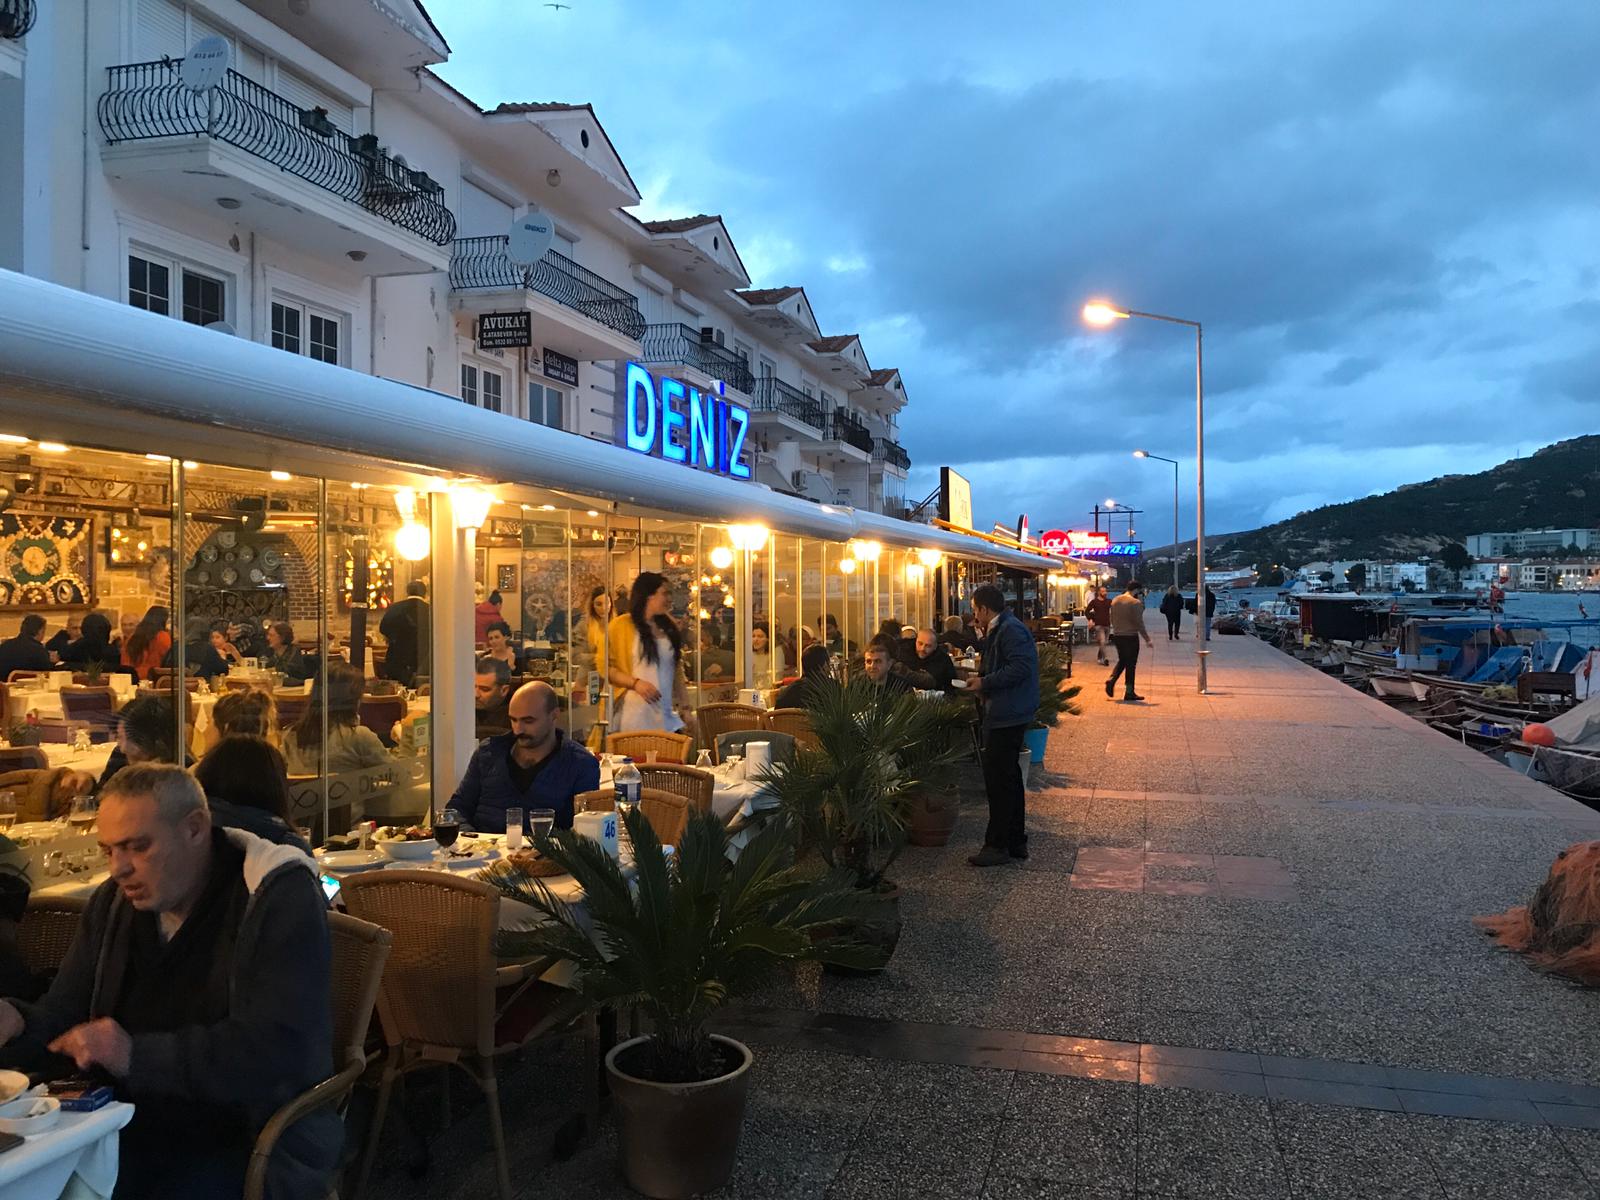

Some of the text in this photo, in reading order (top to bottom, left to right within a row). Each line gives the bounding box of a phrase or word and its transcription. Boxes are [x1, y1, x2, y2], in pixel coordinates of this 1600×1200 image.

[483, 316, 527, 329] AVUKAT
[626, 360, 750, 479] DENİZ
[604, 820, 616, 839] 46
